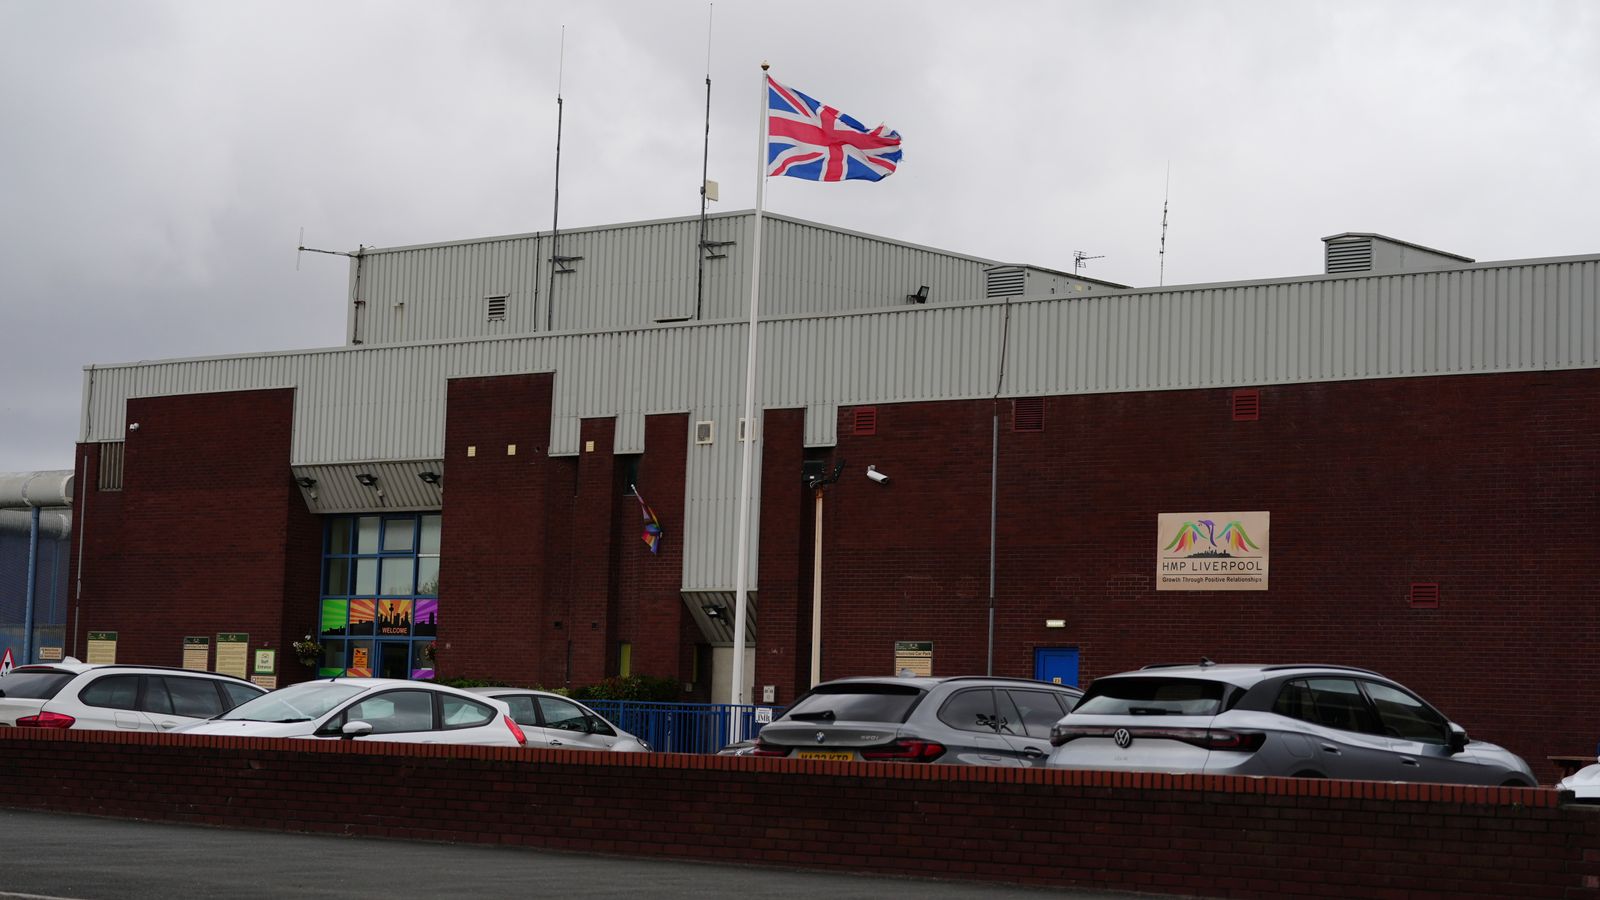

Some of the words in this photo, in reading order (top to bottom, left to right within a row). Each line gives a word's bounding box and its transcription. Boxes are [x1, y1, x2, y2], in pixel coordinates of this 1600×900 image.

[1162, 561, 1187, 571] HMP
[1191, 561, 1263, 571] LIVERPOOL
[1182, 576, 1204, 584] Through
